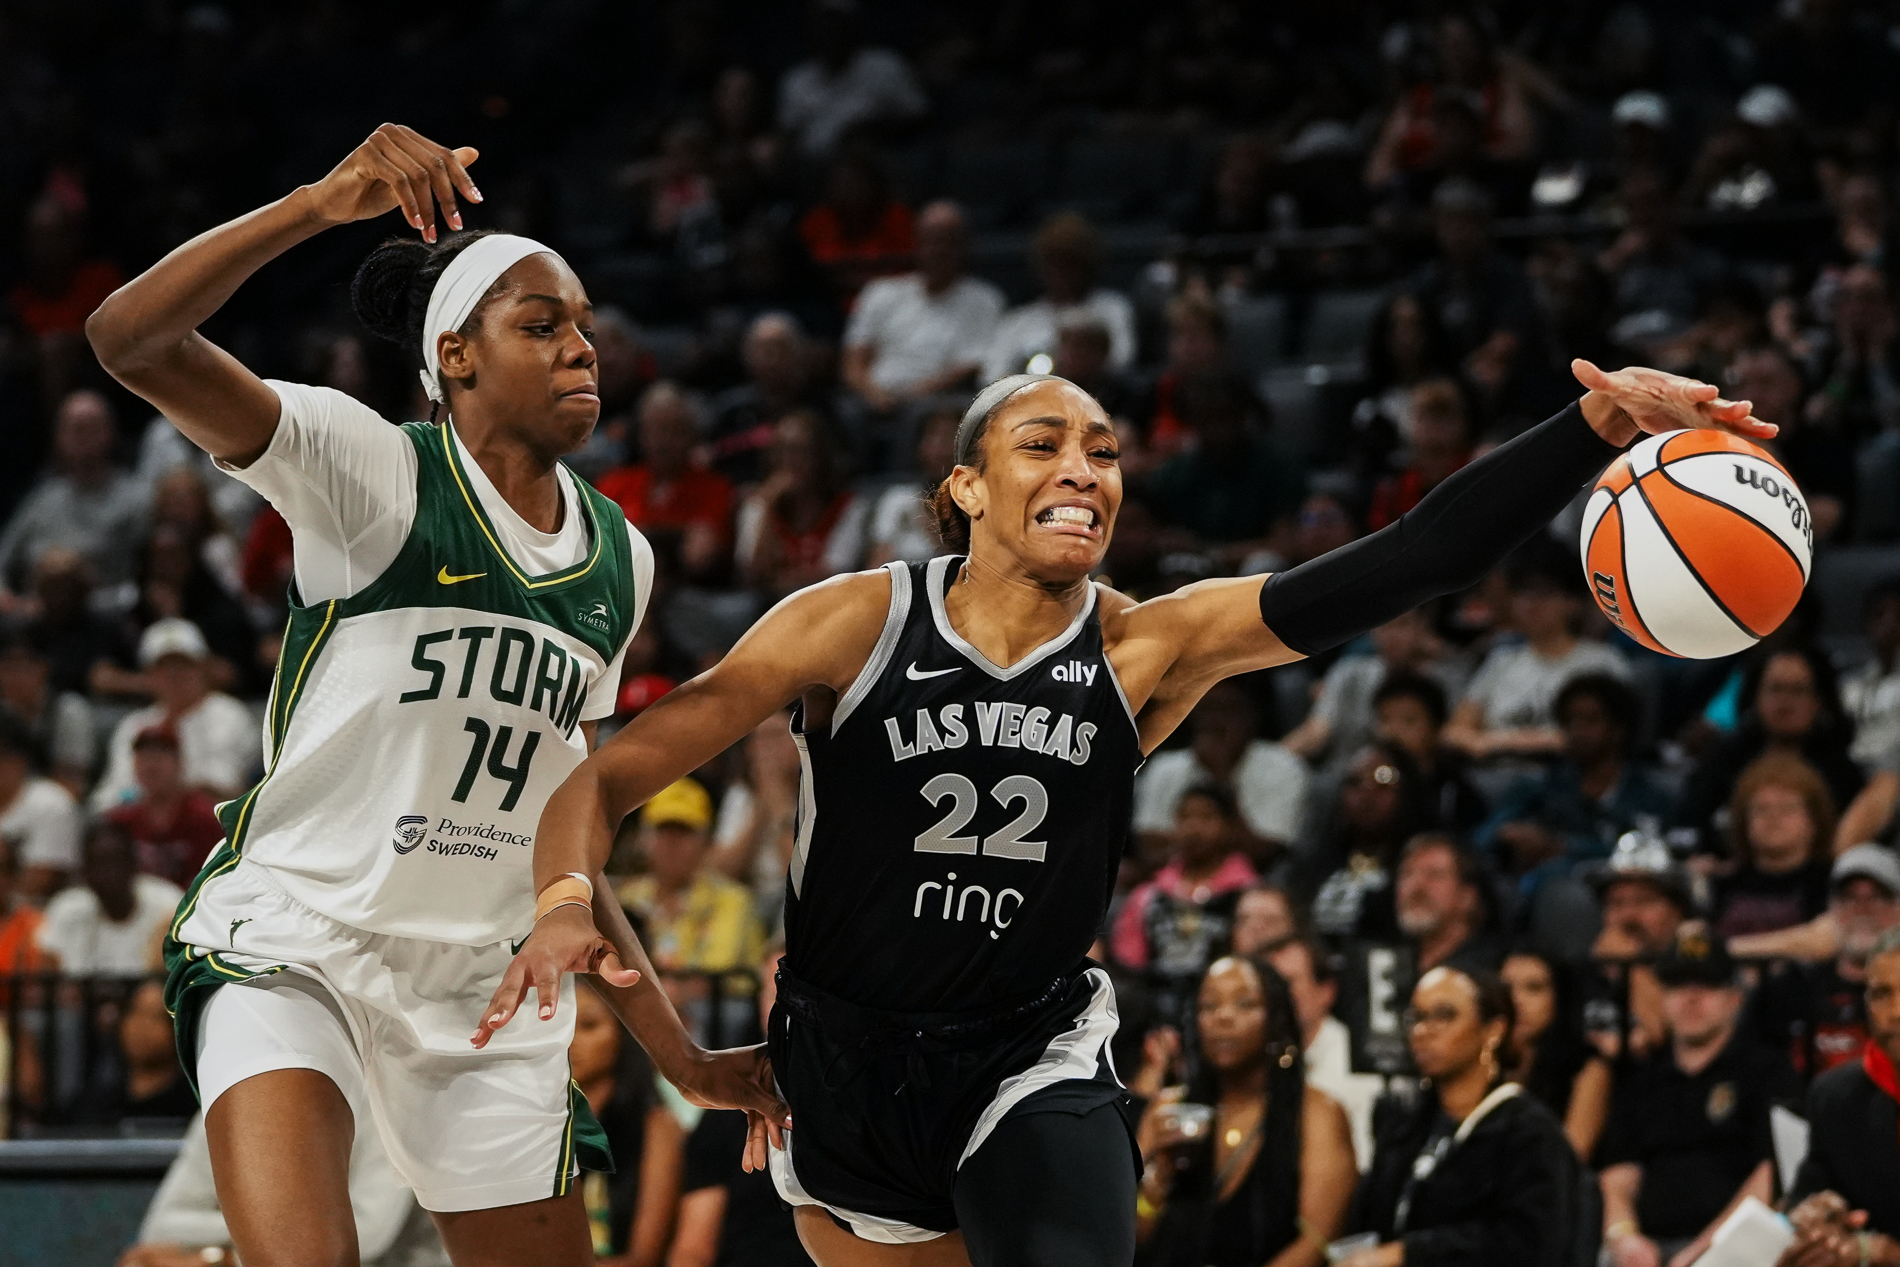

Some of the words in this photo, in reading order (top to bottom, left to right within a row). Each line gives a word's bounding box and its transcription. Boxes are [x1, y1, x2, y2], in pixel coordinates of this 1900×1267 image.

[578, 612, 609, 631] SYMETRA
[399, 626, 588, 741] STORM
[1051, 660, 1098, 686] ally
[451, 716, 542, 812] 14
[884, 703, 969, 762] LAS
[974, 701, 1098, 765] VEGAS
[435, 817, 532, 847] Providence
[913, 773, 1049, 862] 22
[426, 839, 499, 861] SWEDISH
[913, 872, 1025, 940] ring
